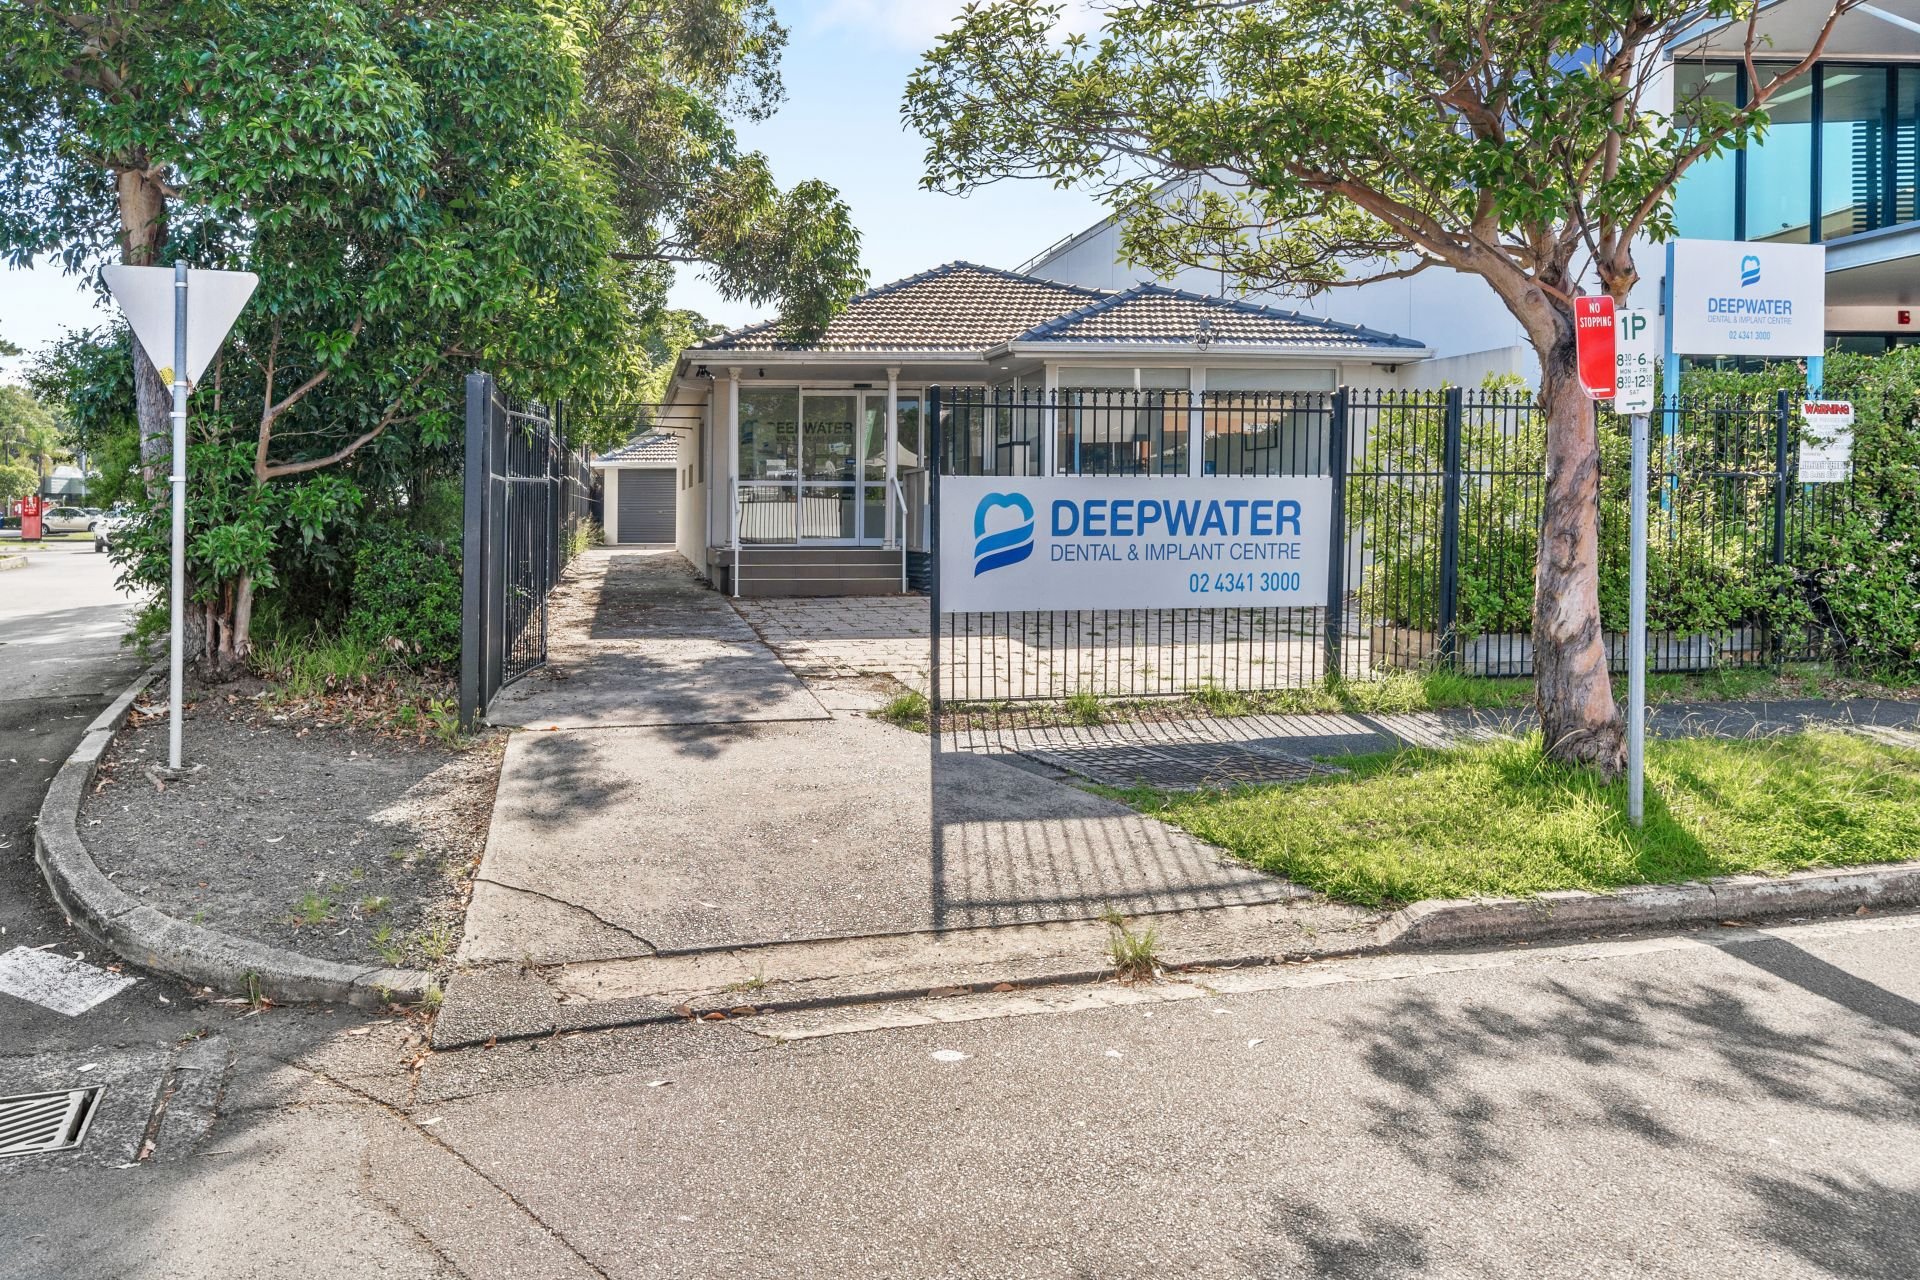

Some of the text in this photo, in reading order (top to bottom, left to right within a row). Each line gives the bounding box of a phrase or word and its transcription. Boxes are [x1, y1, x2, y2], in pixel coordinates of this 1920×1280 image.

[1589, 302, 1600, 313] NO
[1708, 297, 1792, 315] DEEPWATER
[1580, 316, 1612, 328] STOPPING
[1707, 315, 1731, 323] DENTAL
[1738, 316, 1766, 324] IMPLANT
[1767, 316, 1792, 325] CENTRE
[1621, 315, 1646, 340] 1P
[1728, 330, 1771, 340] 02 4341 3000
[1804, 403, 1850, 415] WARNING
[767, 421, 853, 434] EEWATER
[1051, 499, 1302, 536] DEEPWATER
[1051, 542, 1301, 561] DENTAL & IMPLANT CENTRE
[1189, 572, 1300, 592] 02 4341 3000
